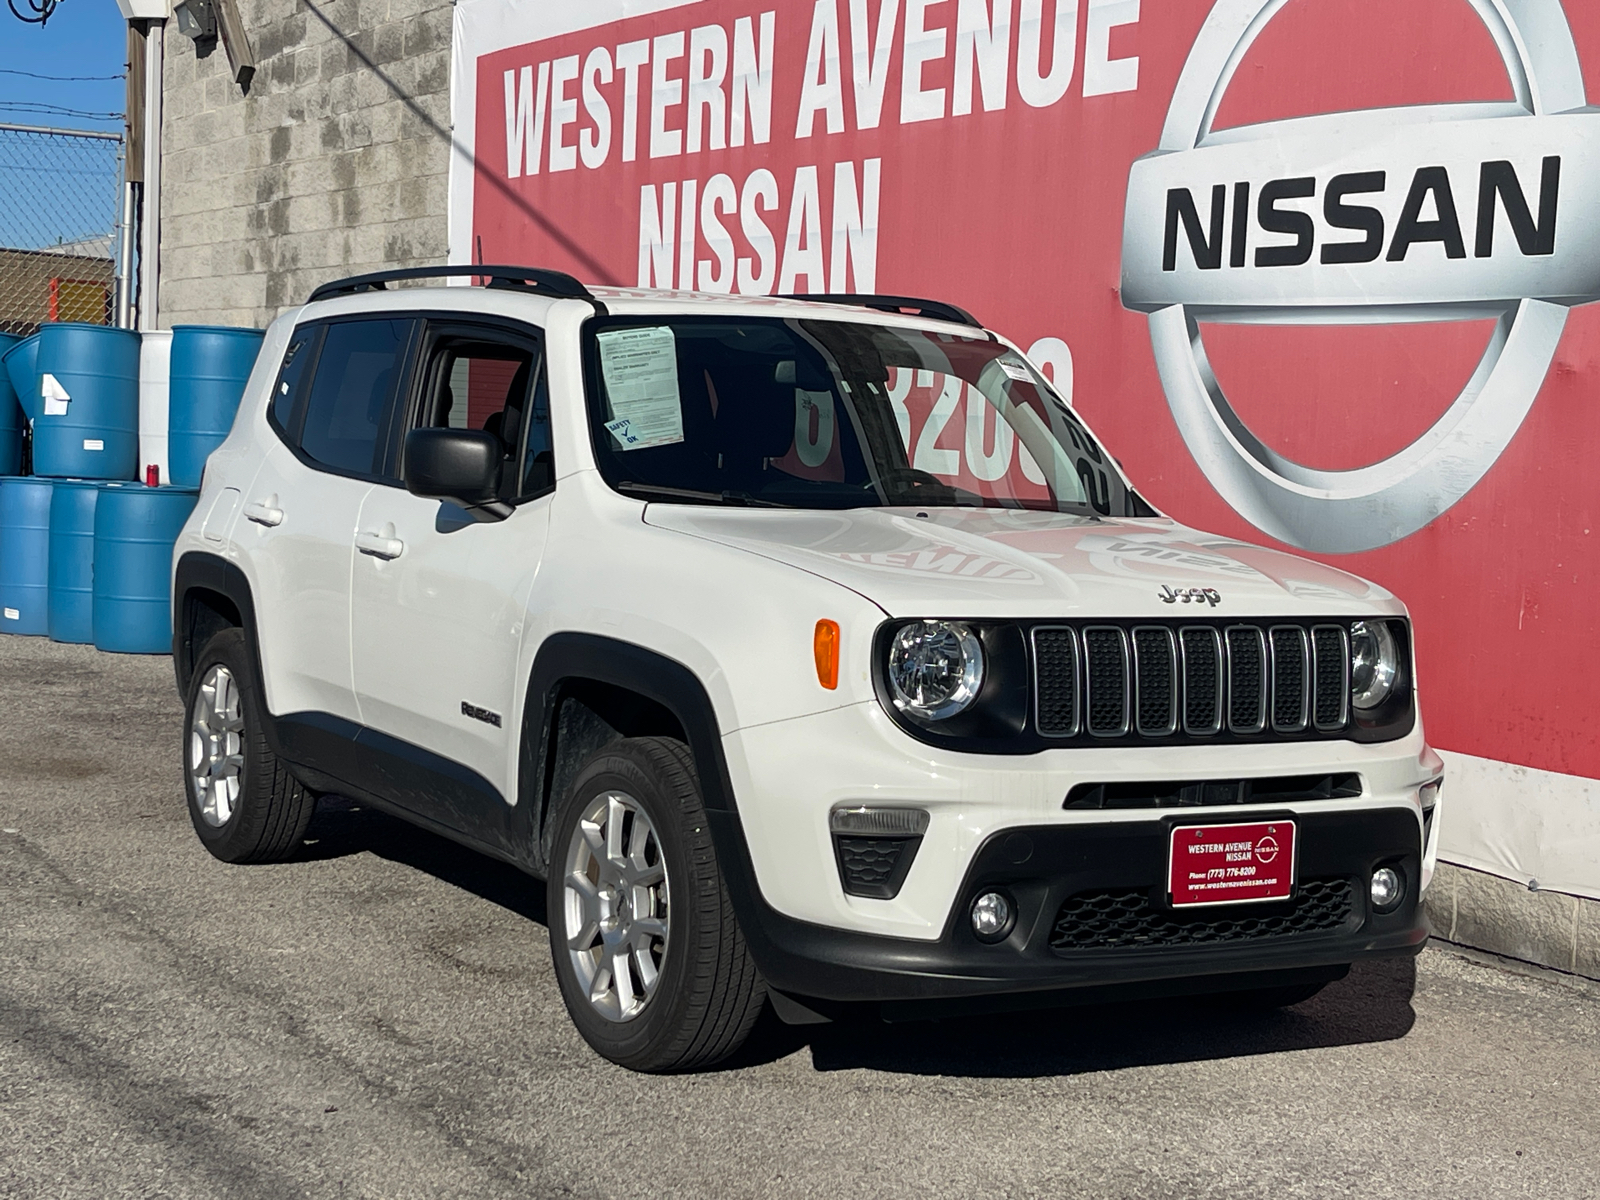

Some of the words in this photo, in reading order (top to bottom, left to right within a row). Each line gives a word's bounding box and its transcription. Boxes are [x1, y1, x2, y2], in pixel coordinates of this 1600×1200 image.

[503, 9, 777, 179] WESTERN
[795, 0, 1141, 139] AVENUE
[1162, 155, 1561, 271] NISSAN
[638, 157, 882, 295] NISSAN
[609, 419, 631, 431] SAFETY
[627, 435, 639, 443] OK
[1157, 584, 1221, 607] Jeep
[1188, 843, 1224, 854] WESTERN
[1224, 841, 1252, 852] AVENUE
[1226, 851, 1252, 862] NISSAN
[1207, 869, 1226, 880] (773)
[1226, 866, 1256, 877] 776-8200
[1188, 879, 1278, 890] www.westernavenissan.com
